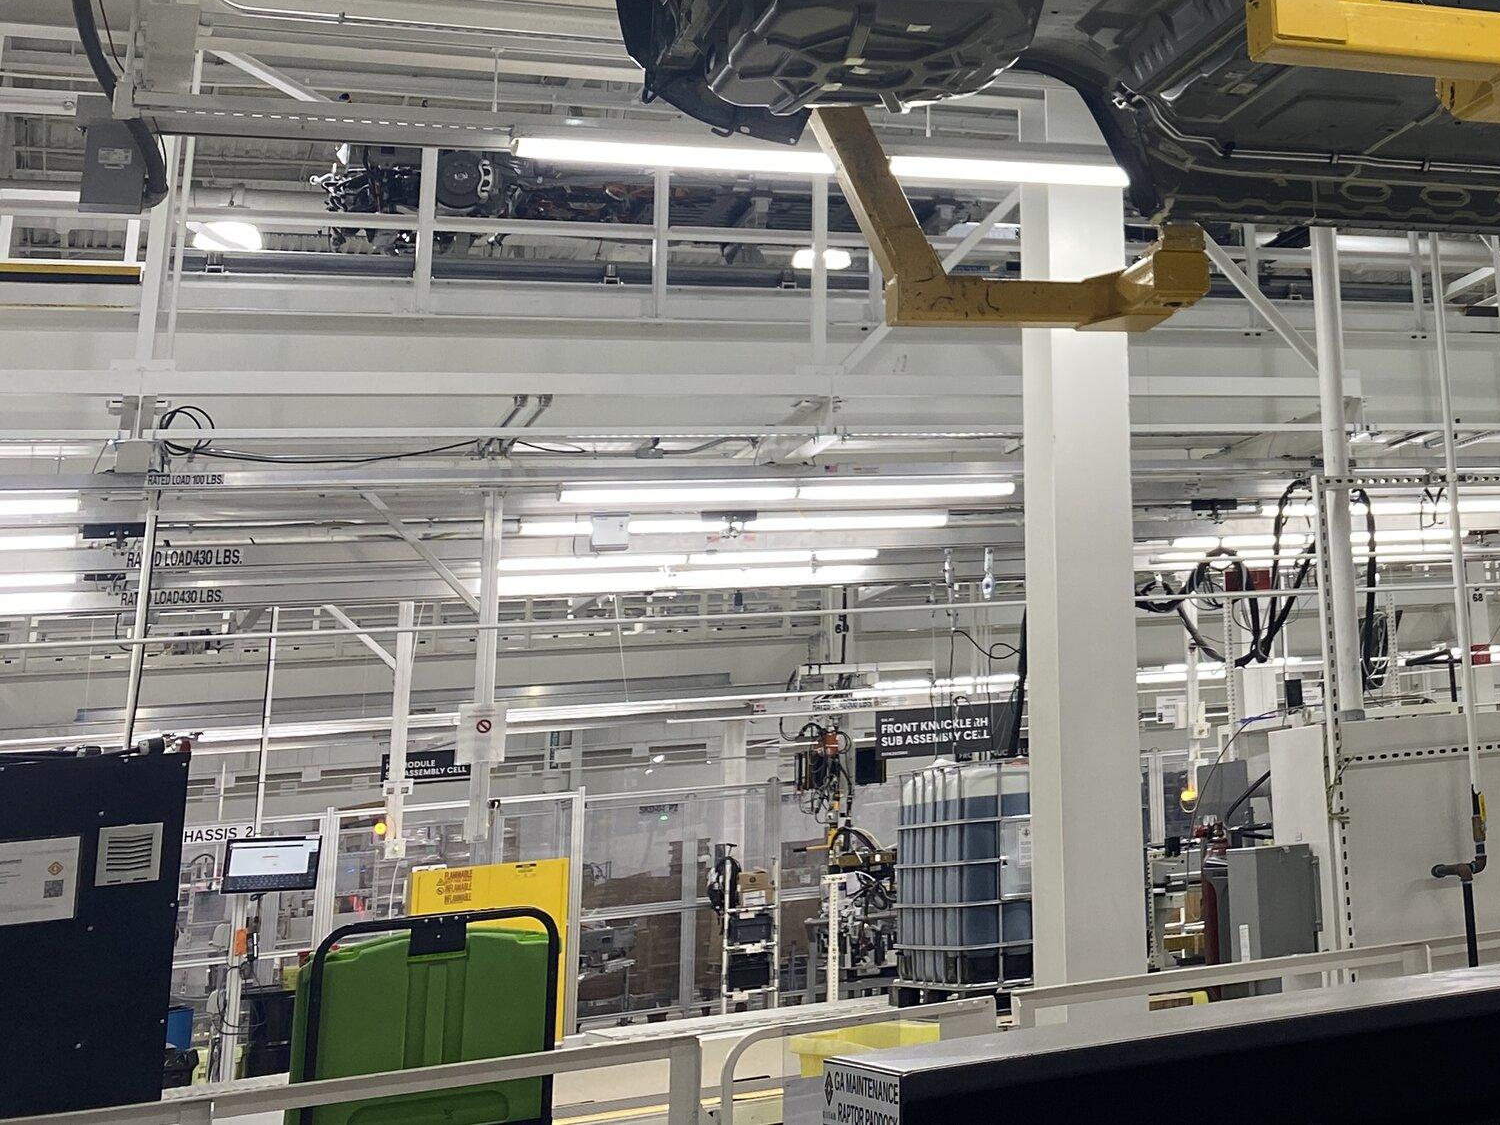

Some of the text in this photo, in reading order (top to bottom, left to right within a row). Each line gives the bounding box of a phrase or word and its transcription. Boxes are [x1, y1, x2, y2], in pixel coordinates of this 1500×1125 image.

[147, 474, 224, 486] RATED LOAD 100 LBS.
[127, 551, 161, 568] RAD
[215, 549, 243, 565] LBS.
[120, 591, 151, 606] RAT
[199, 589, 224, 603] LBS.
[881, 722, 919, 735] FRONT
[973, 716, 988, 728] RH
[881, 735, 904, 747] SUB
[963, 729, 991, 740] CELL
[405, 759, 436, 769] ODULE
[446, 766, 467, 774] CELL
[184, 826, 253, 842] HASSIS 2
[834, 1071, 899, 1105] GA MAINTENANCE
[837, 1103, 863, 1125] RAPTOR
